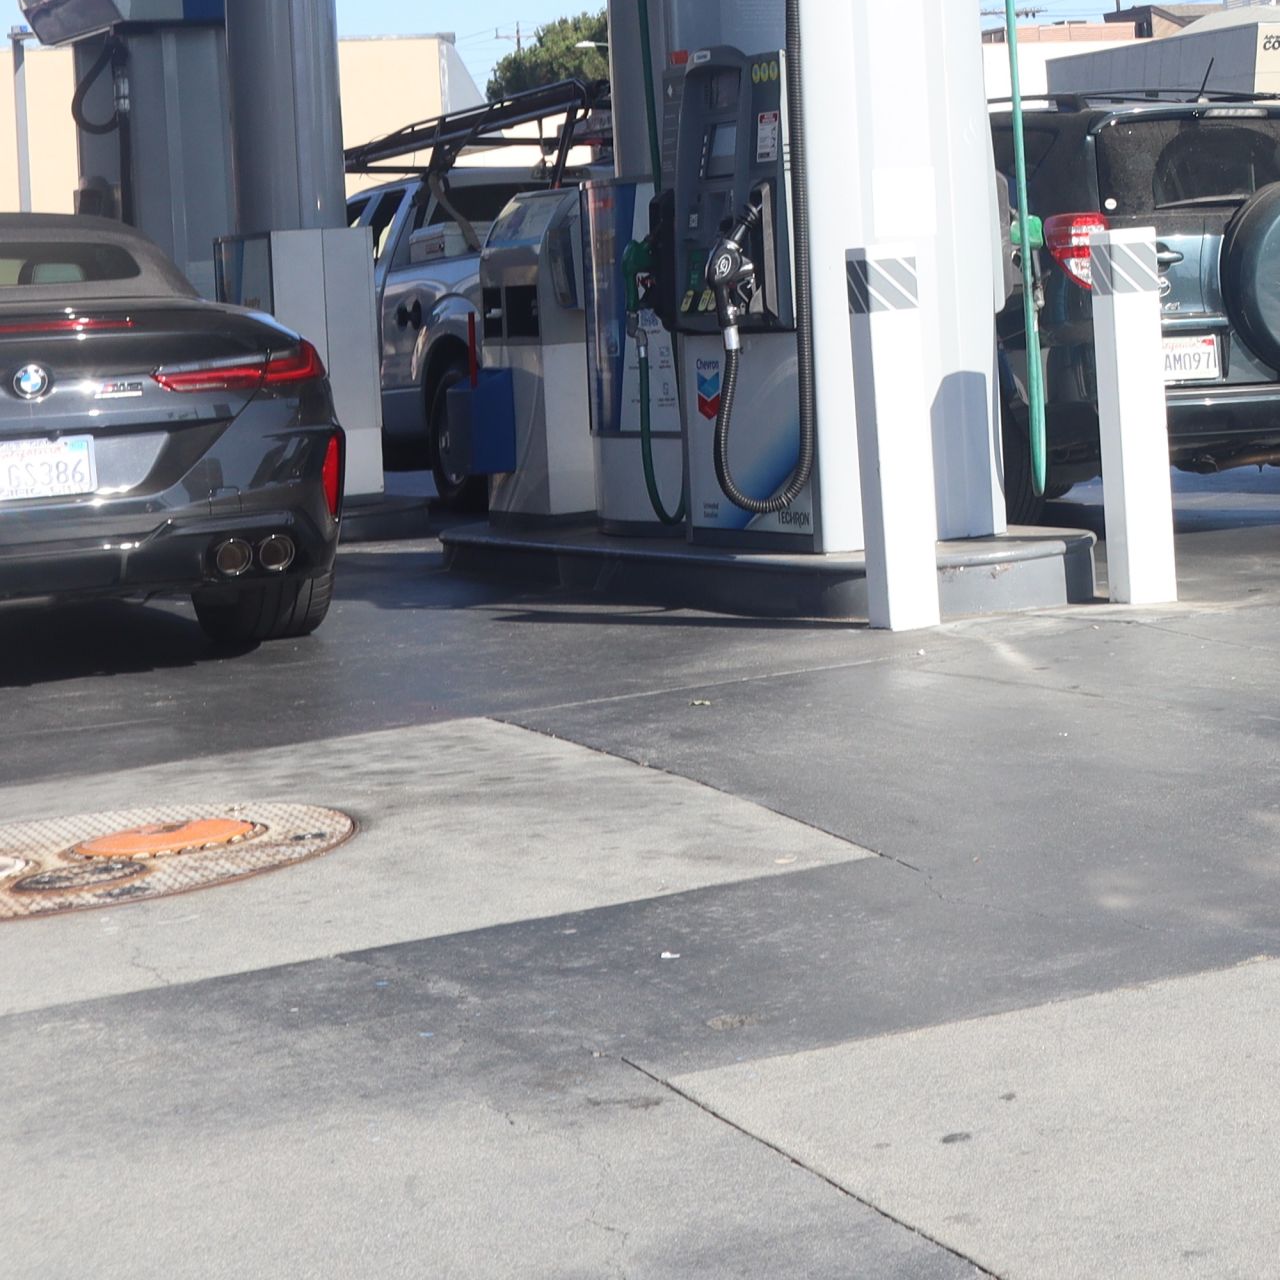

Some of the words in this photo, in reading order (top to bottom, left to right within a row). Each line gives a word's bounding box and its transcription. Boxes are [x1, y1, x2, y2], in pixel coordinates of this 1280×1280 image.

[696, 358, 720, 370] Chevron
[1164, 351, 1211, 372] AM097
[777, 510, 810, 529] TECHRON
